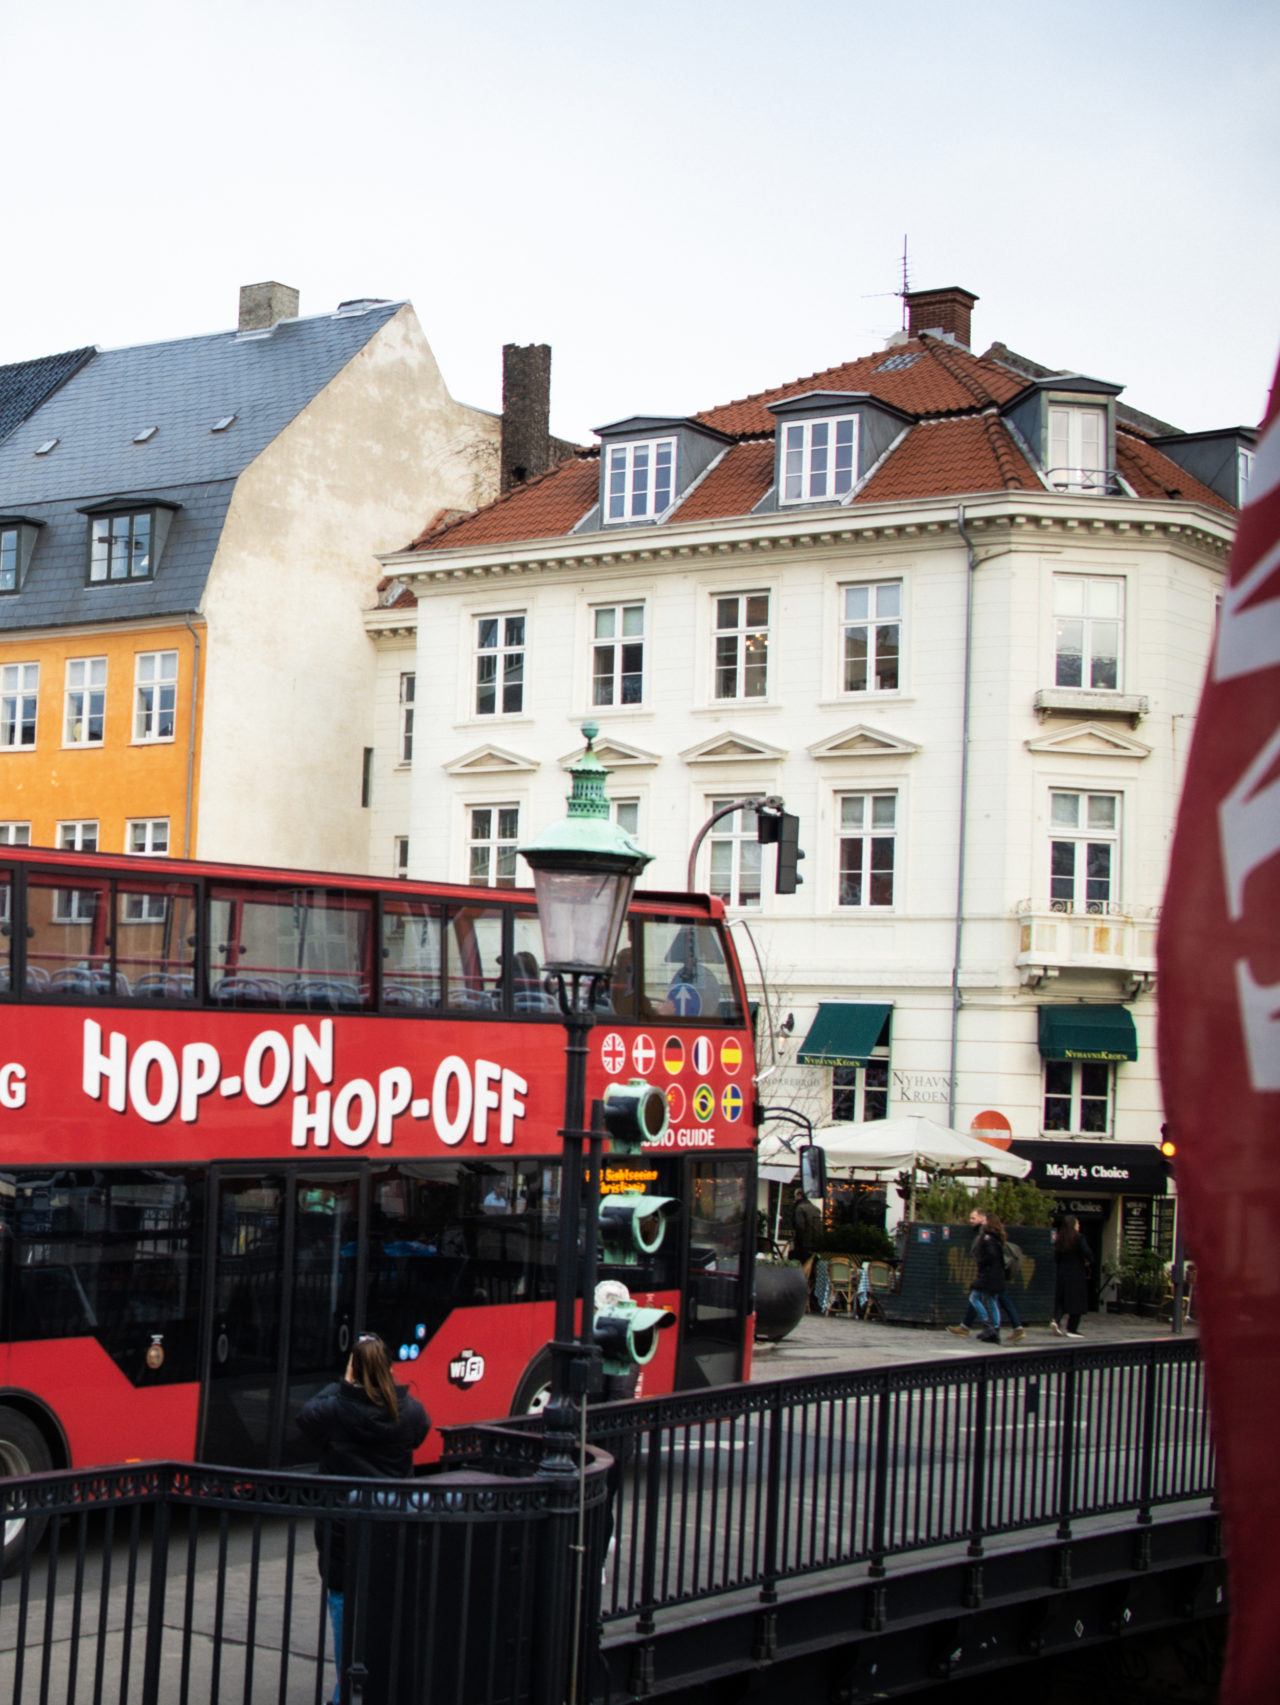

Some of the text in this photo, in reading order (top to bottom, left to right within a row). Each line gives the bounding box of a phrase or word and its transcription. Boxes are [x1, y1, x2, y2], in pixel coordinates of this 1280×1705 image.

[83, 1018, 333, 1123] HOP-ON
[291, 1055, 528, 1147] HOP-OFF
[900, 1086, 949, 1103] KROEN
[677, 1129, 715, 1147] GUIDE
[1046, 1163, 1129, 1180] McJoy's Choice
